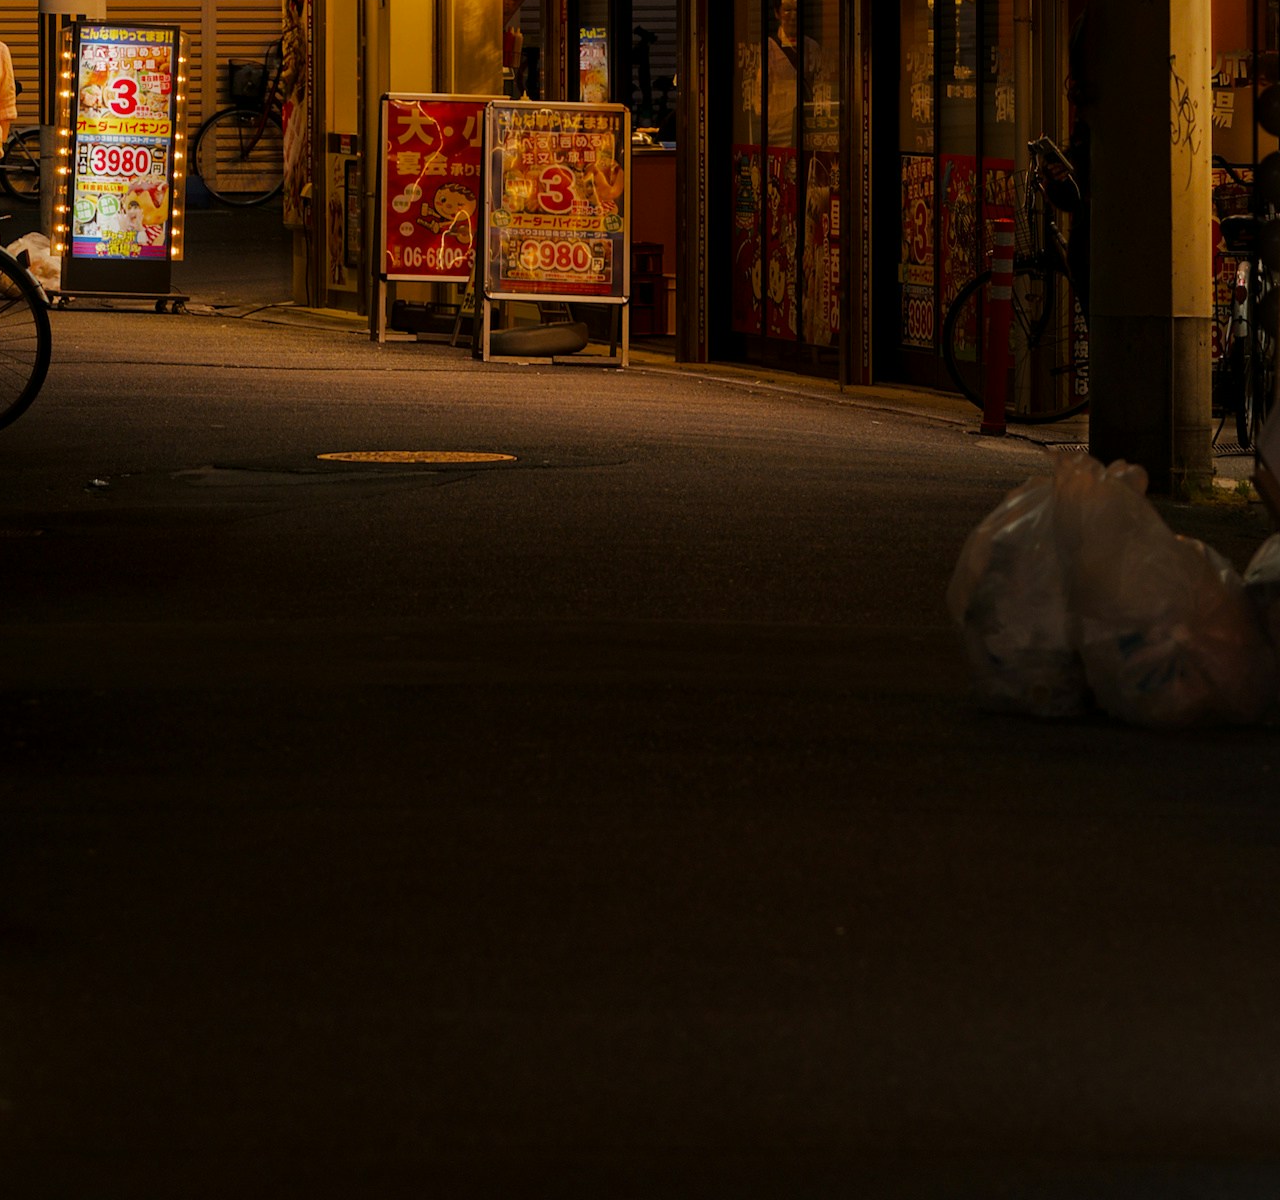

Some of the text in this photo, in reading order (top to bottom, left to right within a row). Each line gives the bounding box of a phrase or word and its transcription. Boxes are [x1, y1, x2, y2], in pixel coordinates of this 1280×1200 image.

[110, 79, 138, 115] 3
[76, 121, 170, 135] オーダーバイキング
[93, 148, 149, 174] 3980
[396, 151, 449, 176] 宴会
[522, 151, 597, 164] 注文し放題
[541, 166, 574, 212] 3
[522, 242, 590, 270] 3980
[907, 298, 935, 341] 3980
